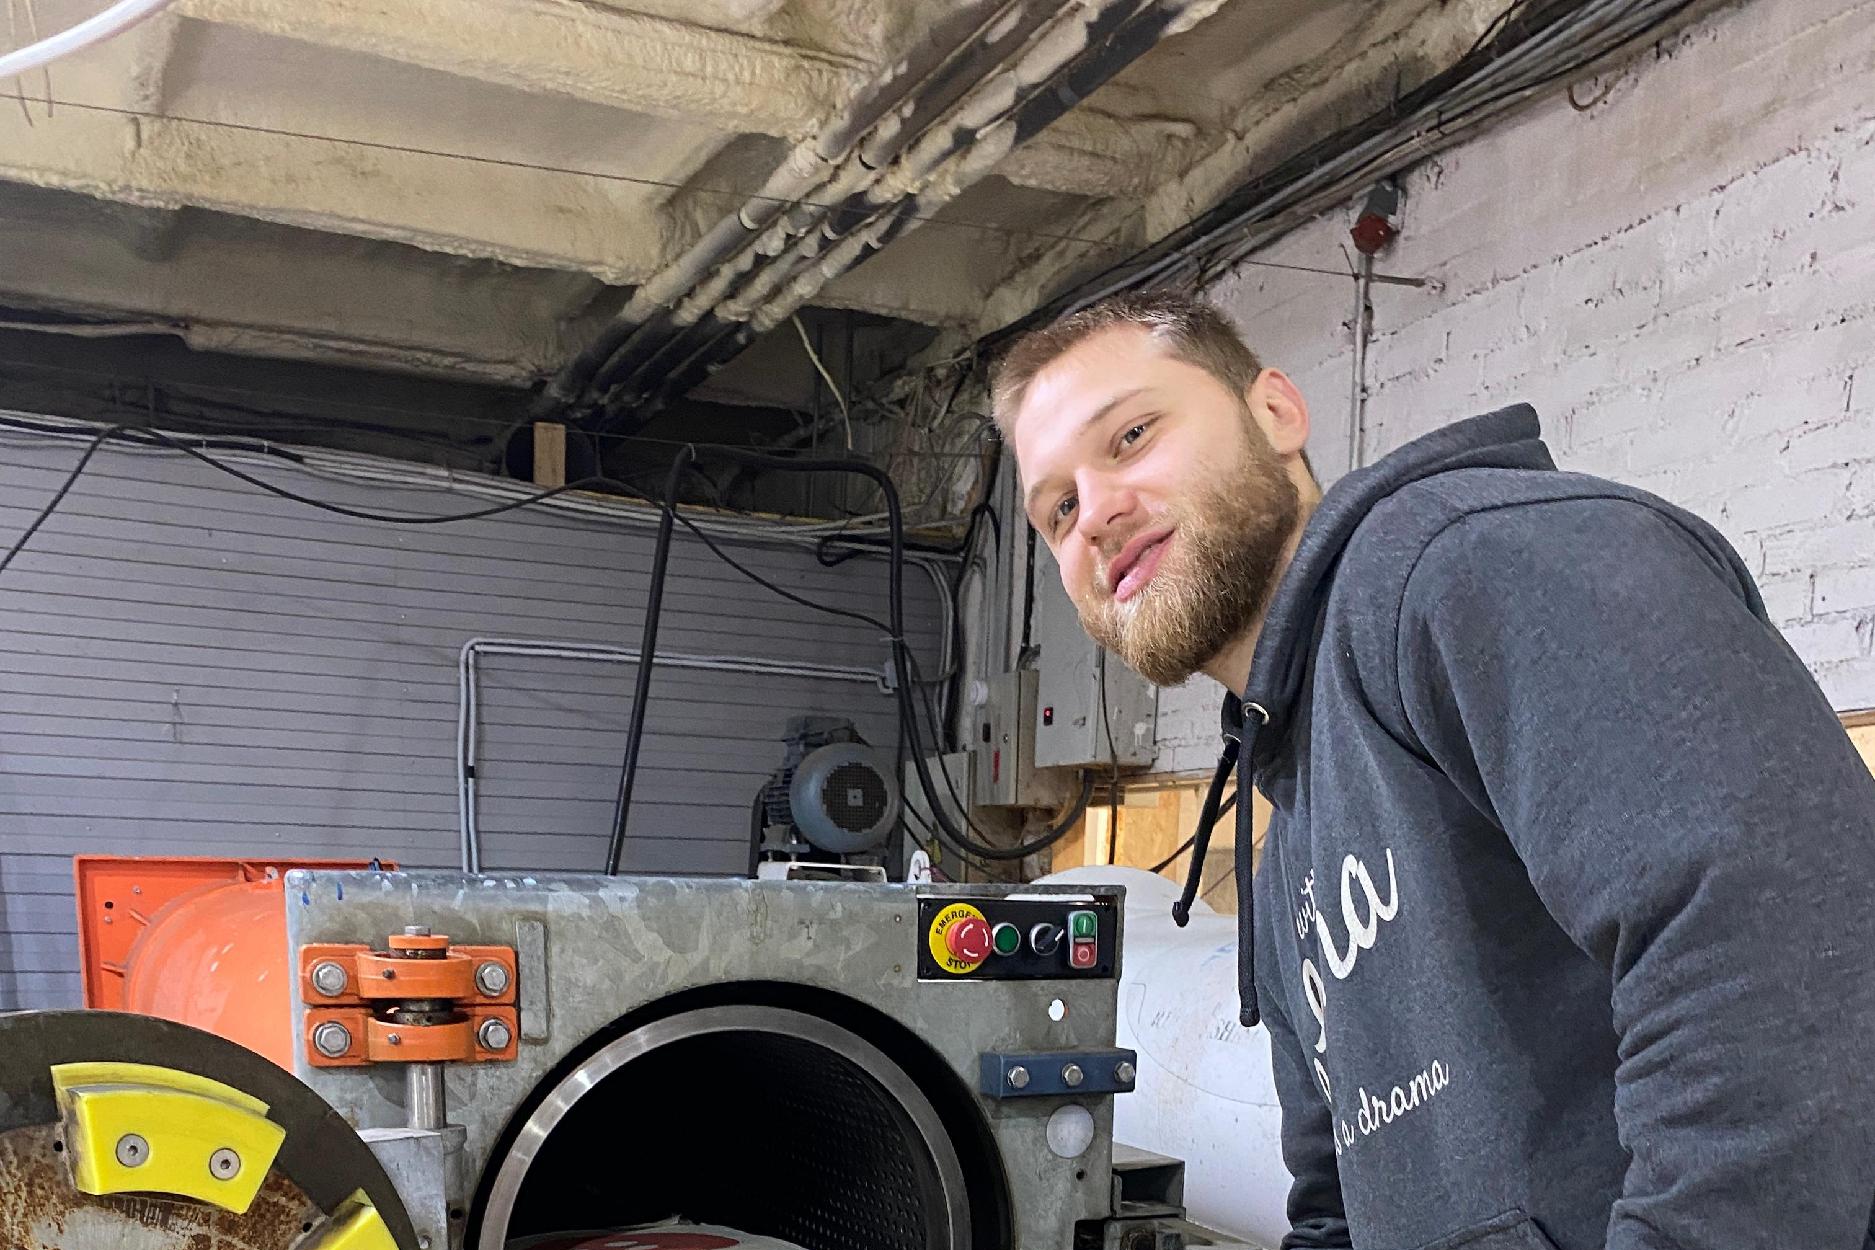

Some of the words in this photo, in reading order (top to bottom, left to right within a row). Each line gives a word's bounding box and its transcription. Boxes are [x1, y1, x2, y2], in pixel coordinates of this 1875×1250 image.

[936, 909, 976, 935] EMERGE
[1341, 1119, 1355, 1148] a
[1357, 1059, 1450, 1136] drama
